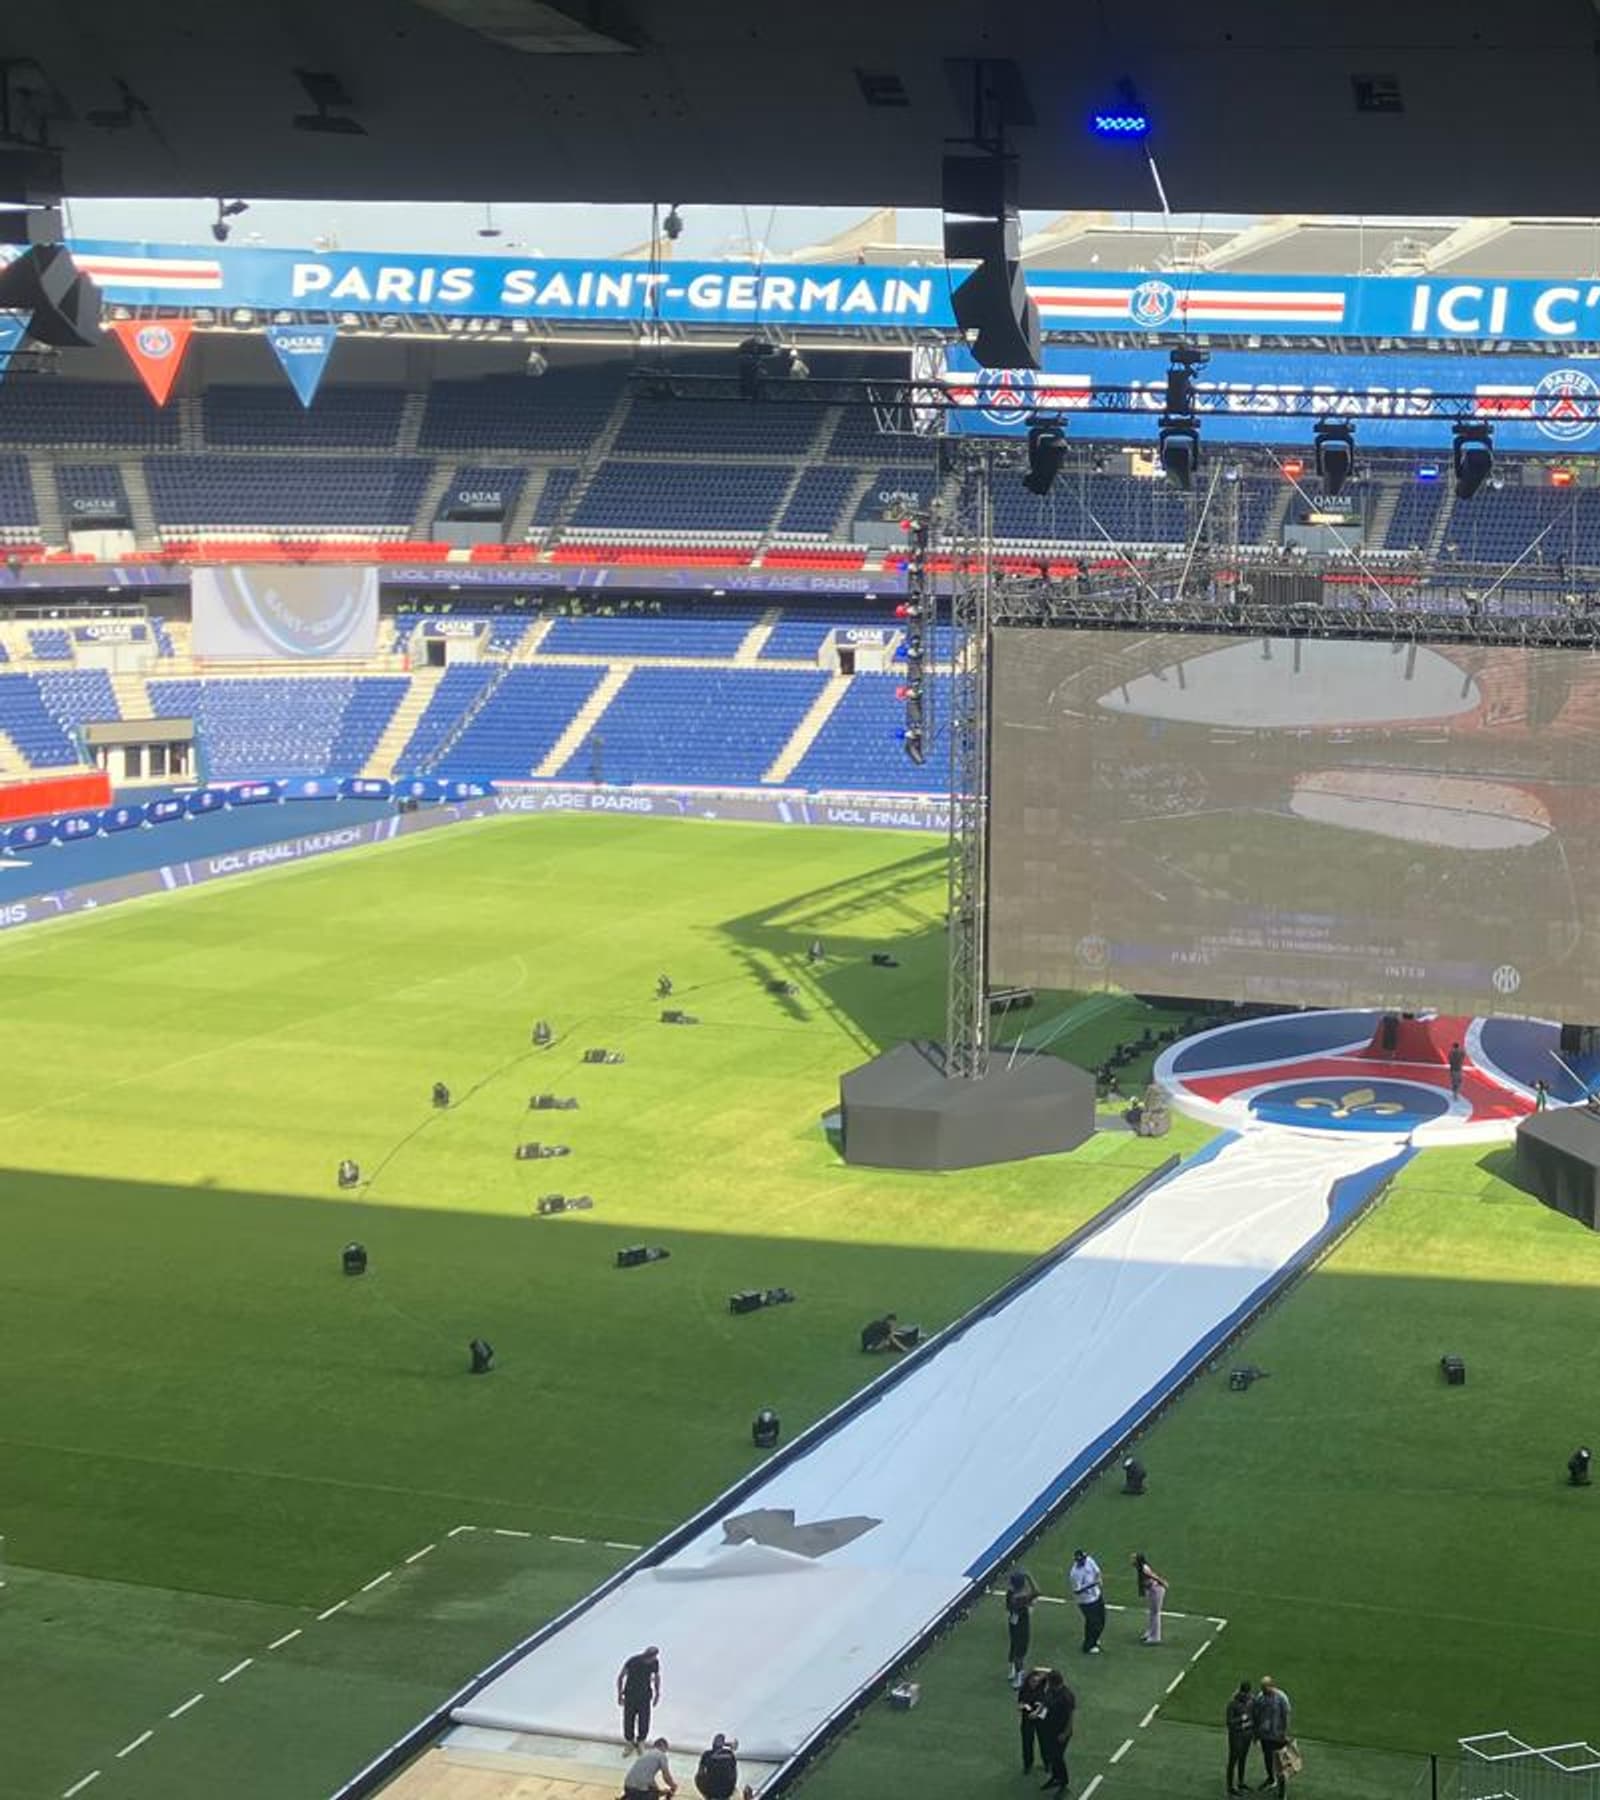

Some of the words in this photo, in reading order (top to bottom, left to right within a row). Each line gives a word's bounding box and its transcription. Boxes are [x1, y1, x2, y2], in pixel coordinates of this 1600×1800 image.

[291, 263, 475, 303] PARIS
[500, 269, 932, 313] SAINT-GERMAIN
[1411, 285, 1508, 334] ICI
[1314, 495, 1352, 507] QATAR
[727, 576, 762, 589] WE
[767, 576, 807, 591] ARE
[810, 577, 870, 591] PARIS
[495, 795, 535, 810] WE
[542, 793, 587, 808] ARE
[591, 795, 653, 812] PARIS
[828, 808, 864, 823] UCL
[869, 811, 921, 825] FINAL
[209, 855, 246, 874] UCL
[248, 844, 294, 867] FINAL
[304, 828, 361, 852] MUNICH
